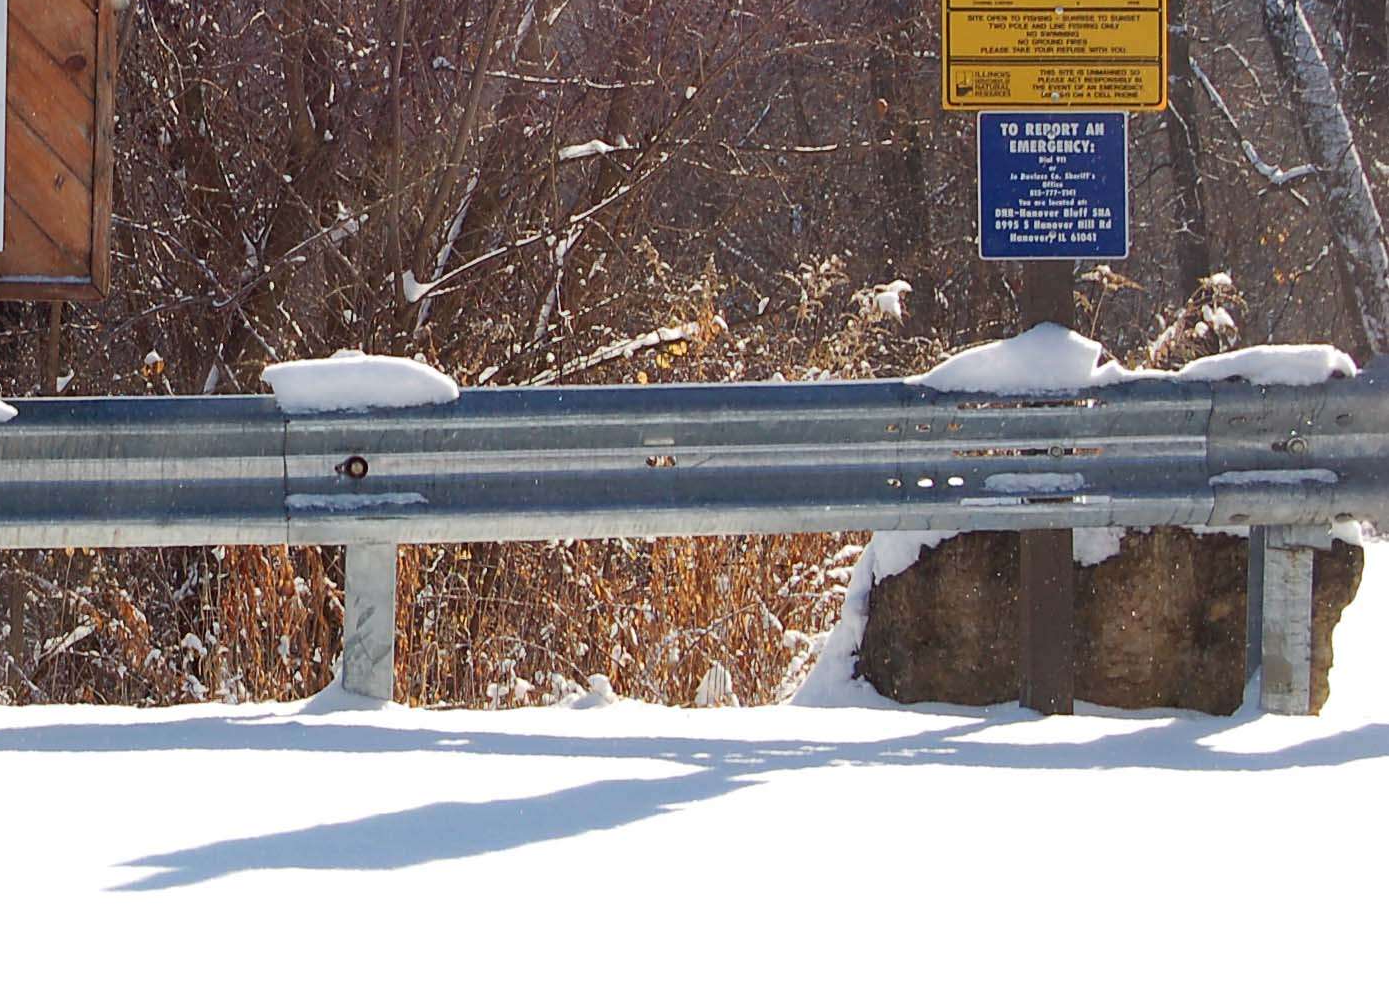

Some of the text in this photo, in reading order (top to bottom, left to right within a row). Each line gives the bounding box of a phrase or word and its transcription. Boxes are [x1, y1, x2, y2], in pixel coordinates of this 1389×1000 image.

[1000, 123, 1105, 136] TO REPORT AN
[1009, 140, 1095, 153] EMERGENCY:
[1063, 208, 1088, 217] Bluff
[995, 219, 1112, 229] 8995 S Hanover Hill Rd
[1058, 233, 1067, 242] IL
[1071, 232, 1097, 242] 61041
